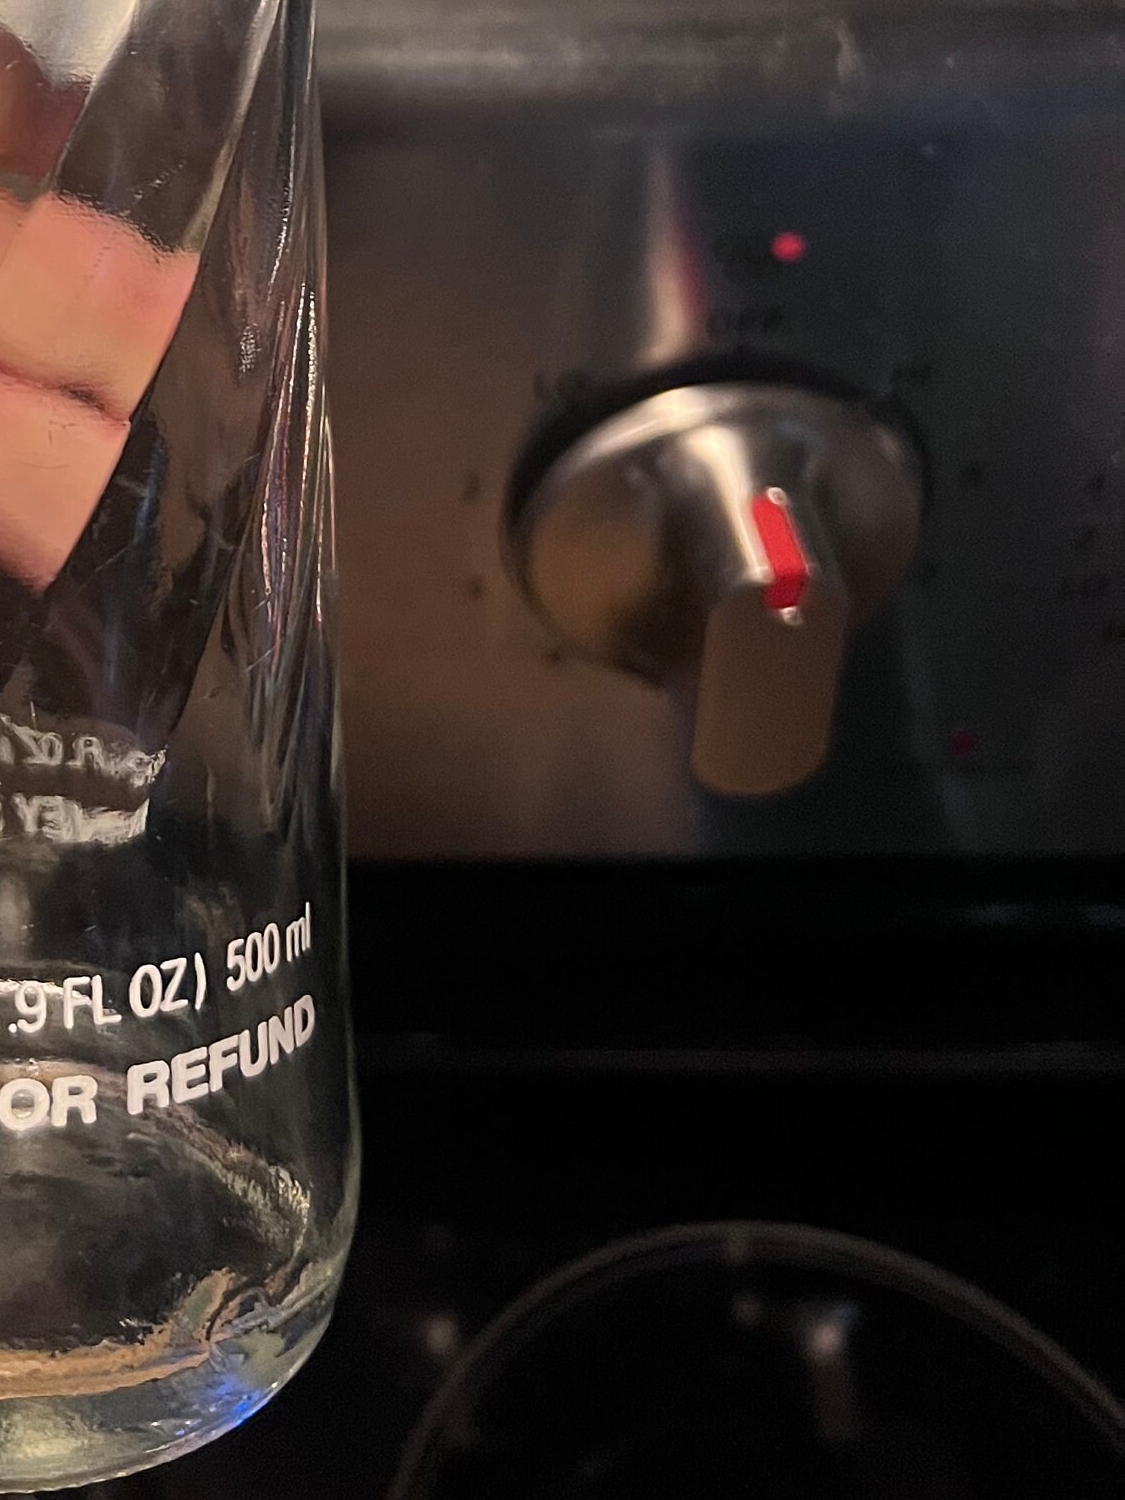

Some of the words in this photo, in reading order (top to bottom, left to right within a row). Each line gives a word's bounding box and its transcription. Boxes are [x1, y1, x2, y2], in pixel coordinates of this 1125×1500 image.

[63, 974, 122, 1030] FL
[225, 922, 279, 991] 500
[286, 901, 311, 962] ml
[126, 993, 316, 1114] REFUND
